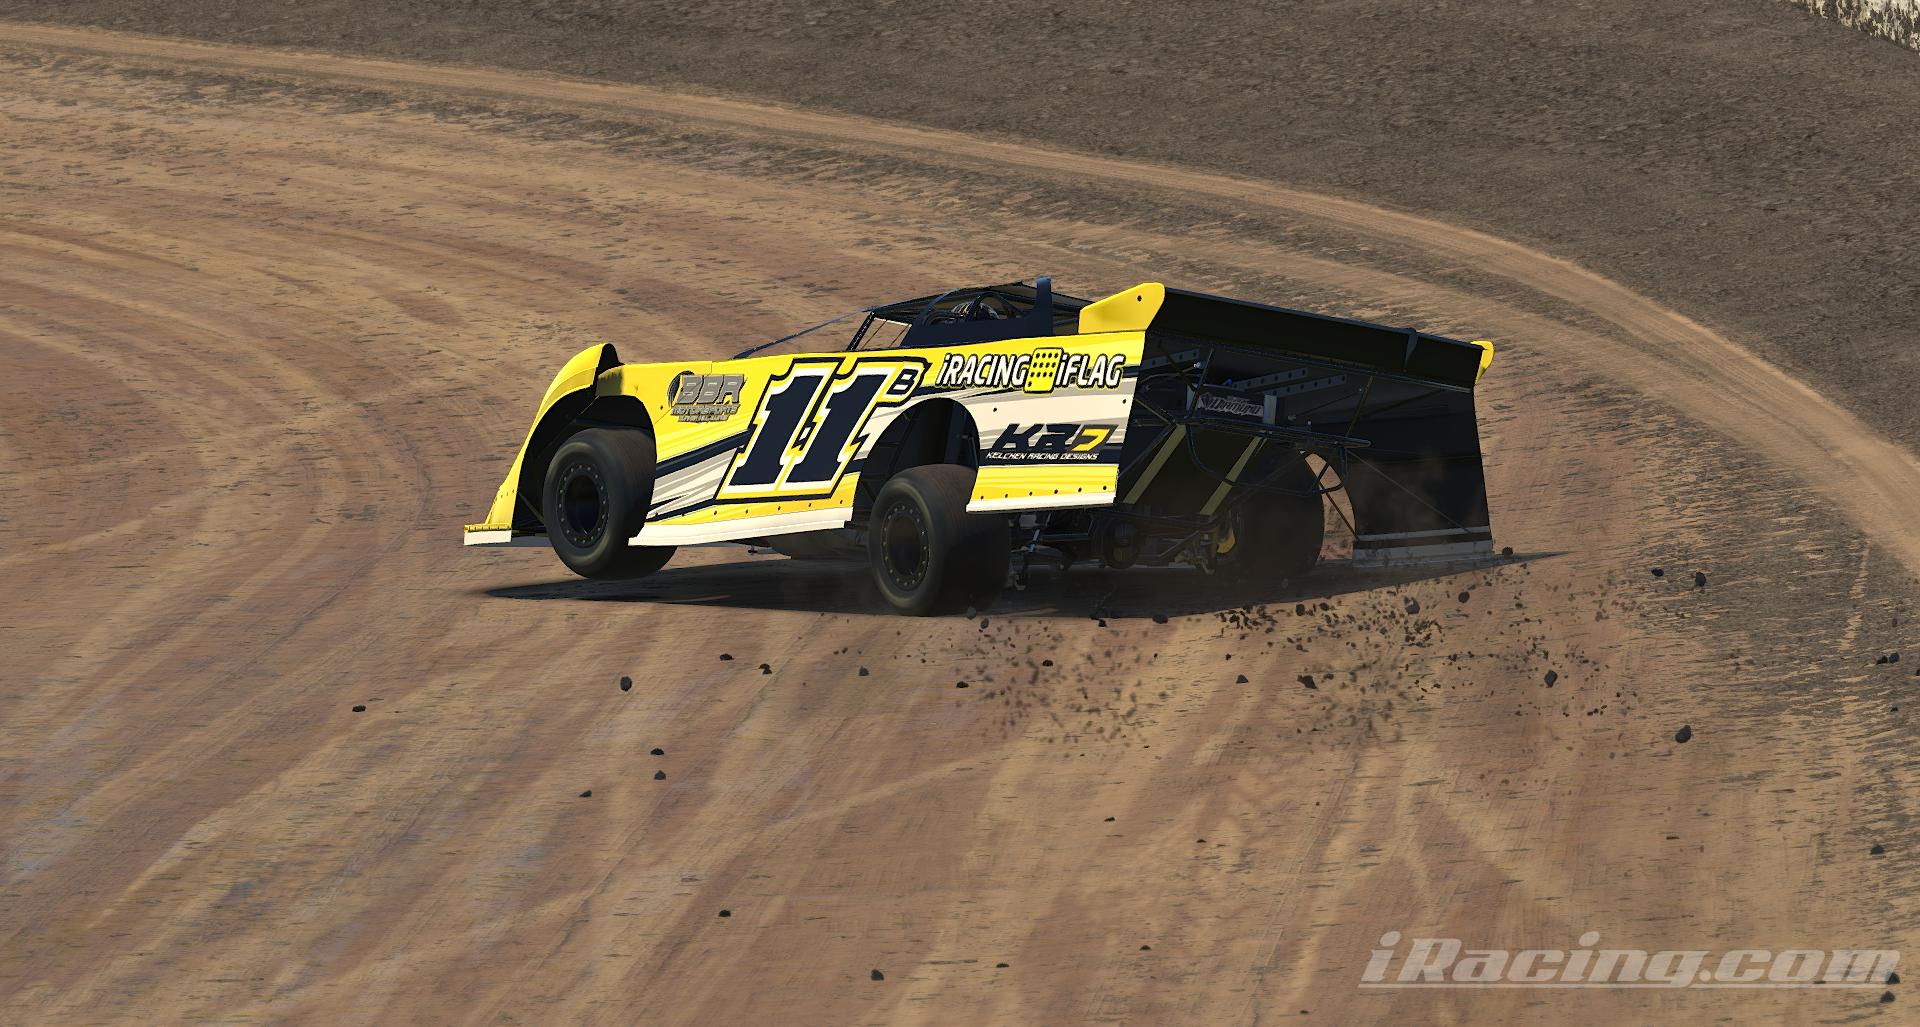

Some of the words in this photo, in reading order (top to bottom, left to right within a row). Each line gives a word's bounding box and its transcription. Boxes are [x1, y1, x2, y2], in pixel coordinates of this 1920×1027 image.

[935, 352, 1030, 388] iRACING
[1054, 353, 1126, 388] iFLAG
[677, 375, 745, 404] BBR
[721, 365, 898, 494] 11
[986, 451, 1025, 460] KELCHEN
[1027, 452, 1059, 460] RACING
[1060, 452, 1099, 461] DESIGNS
